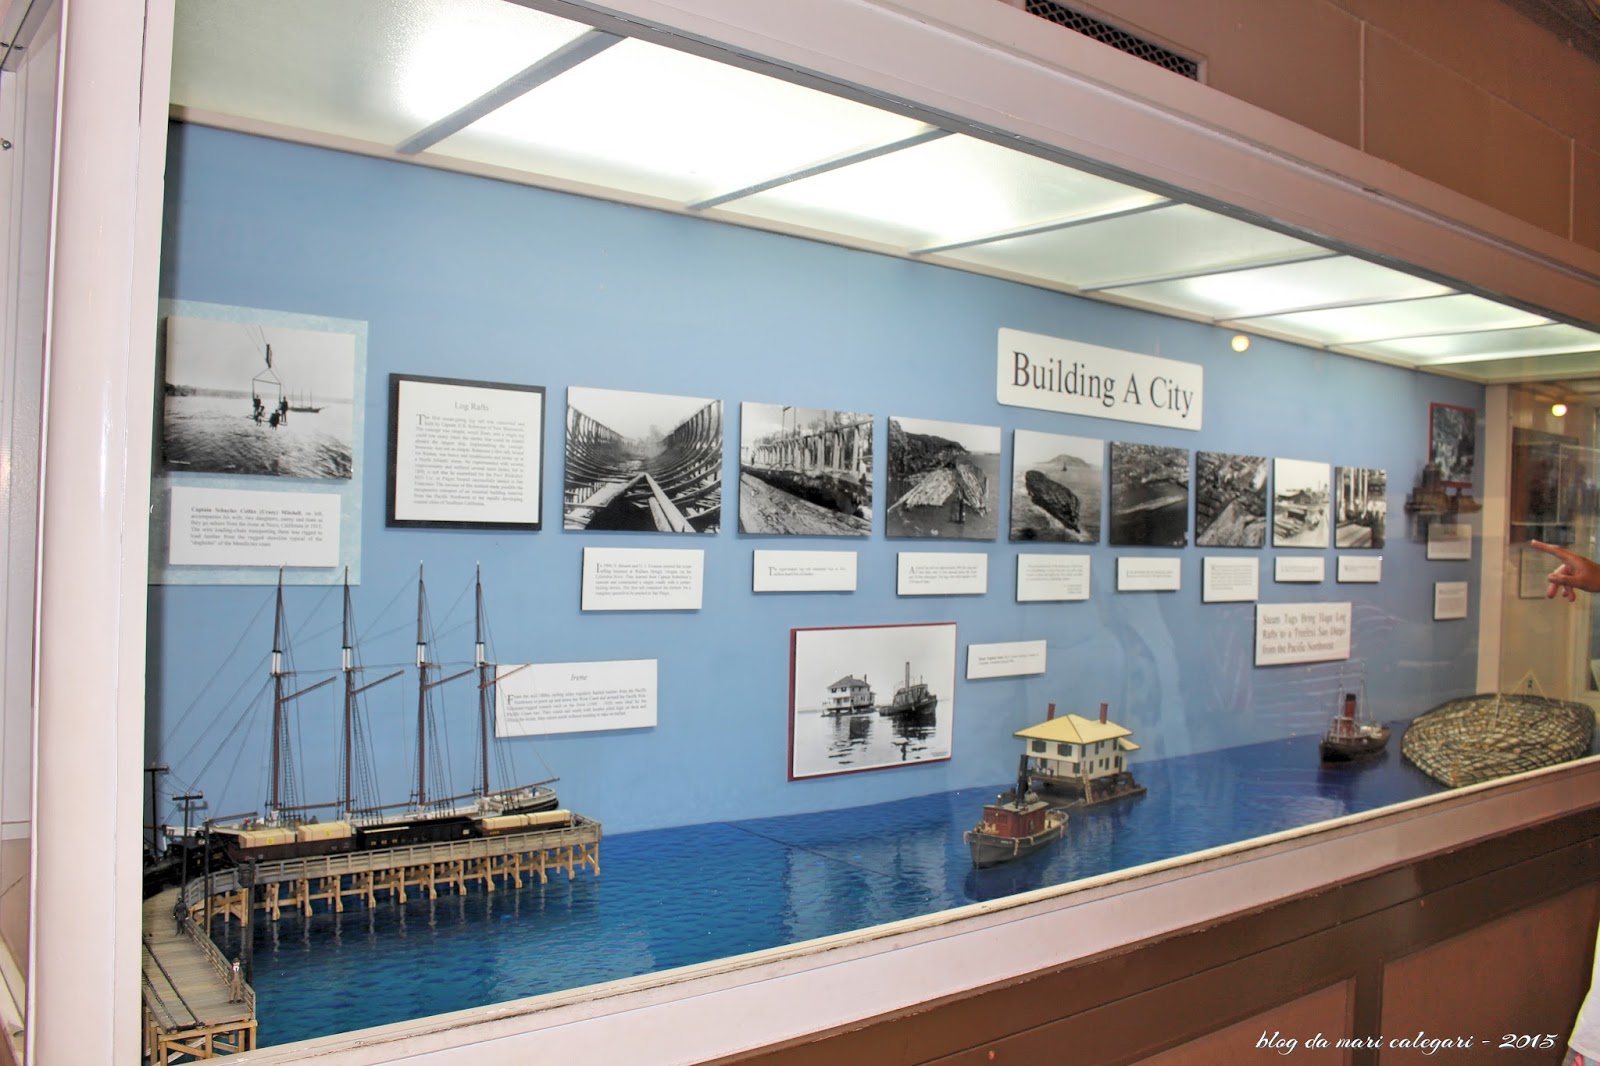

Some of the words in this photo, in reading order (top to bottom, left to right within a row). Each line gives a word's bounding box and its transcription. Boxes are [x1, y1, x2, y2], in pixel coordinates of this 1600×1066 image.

[1011, 350, 1116, 408] Building
[1122, 372, 1142, 405] A
[1150, 376, 1194, 418] City
[455, 401, 469, 412] Log
[470, 402, 489, 411] Rafts
[569, 673, 589, 683] Irene
